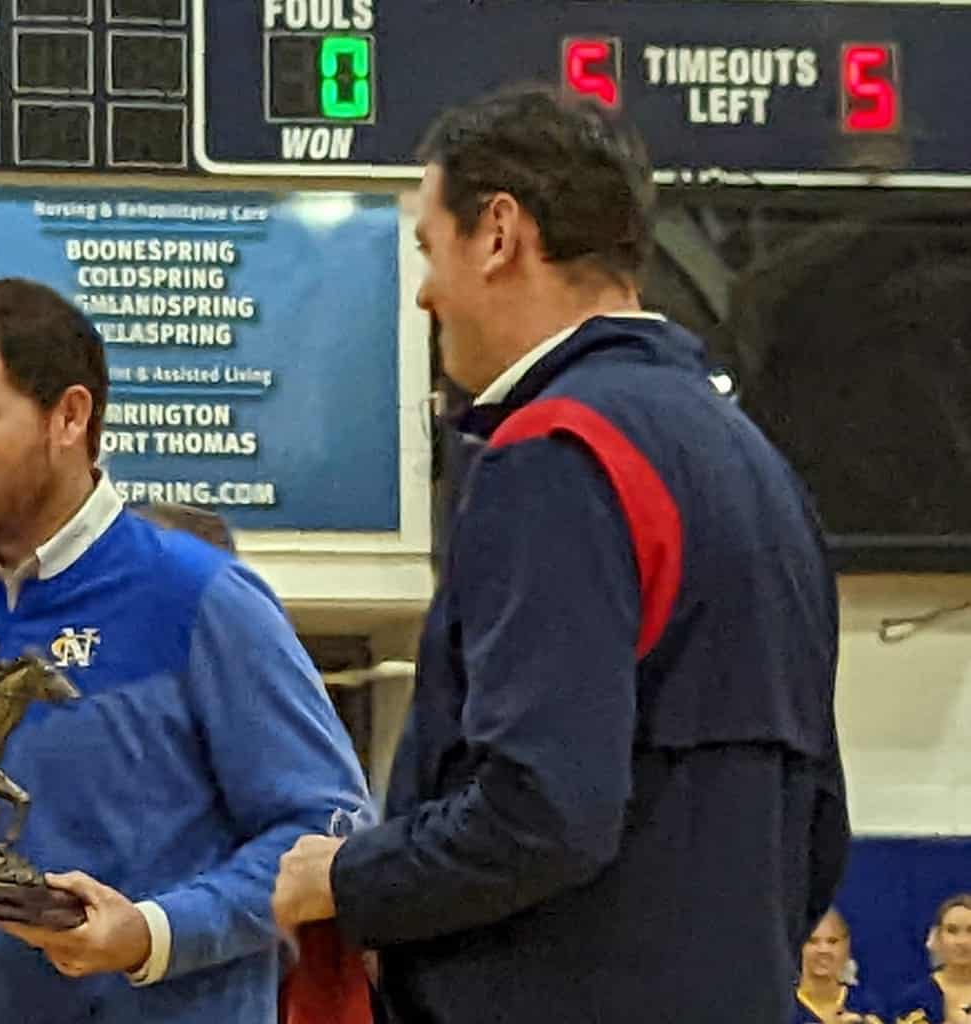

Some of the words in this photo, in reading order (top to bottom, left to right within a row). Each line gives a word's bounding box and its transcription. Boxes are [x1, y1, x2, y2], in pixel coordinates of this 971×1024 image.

[264, 0, 374, 30] FOULS
[321, 36, 369, 118] 0
[644, 46, 819, 87] TIMEOUTS
[843, 46, 896, 130] 5
[689, 87, 771, 125] LEFT
[281, 127, 355, 160] WON
[65, 240, 236, 264] BOONESPRING
[78, 267, 225, 290] COLDSPRING
[153, 368, 220, 383] Assisted
[225, 367, 272, 387] Living
[153, 431, 257, 455] THOMAS
